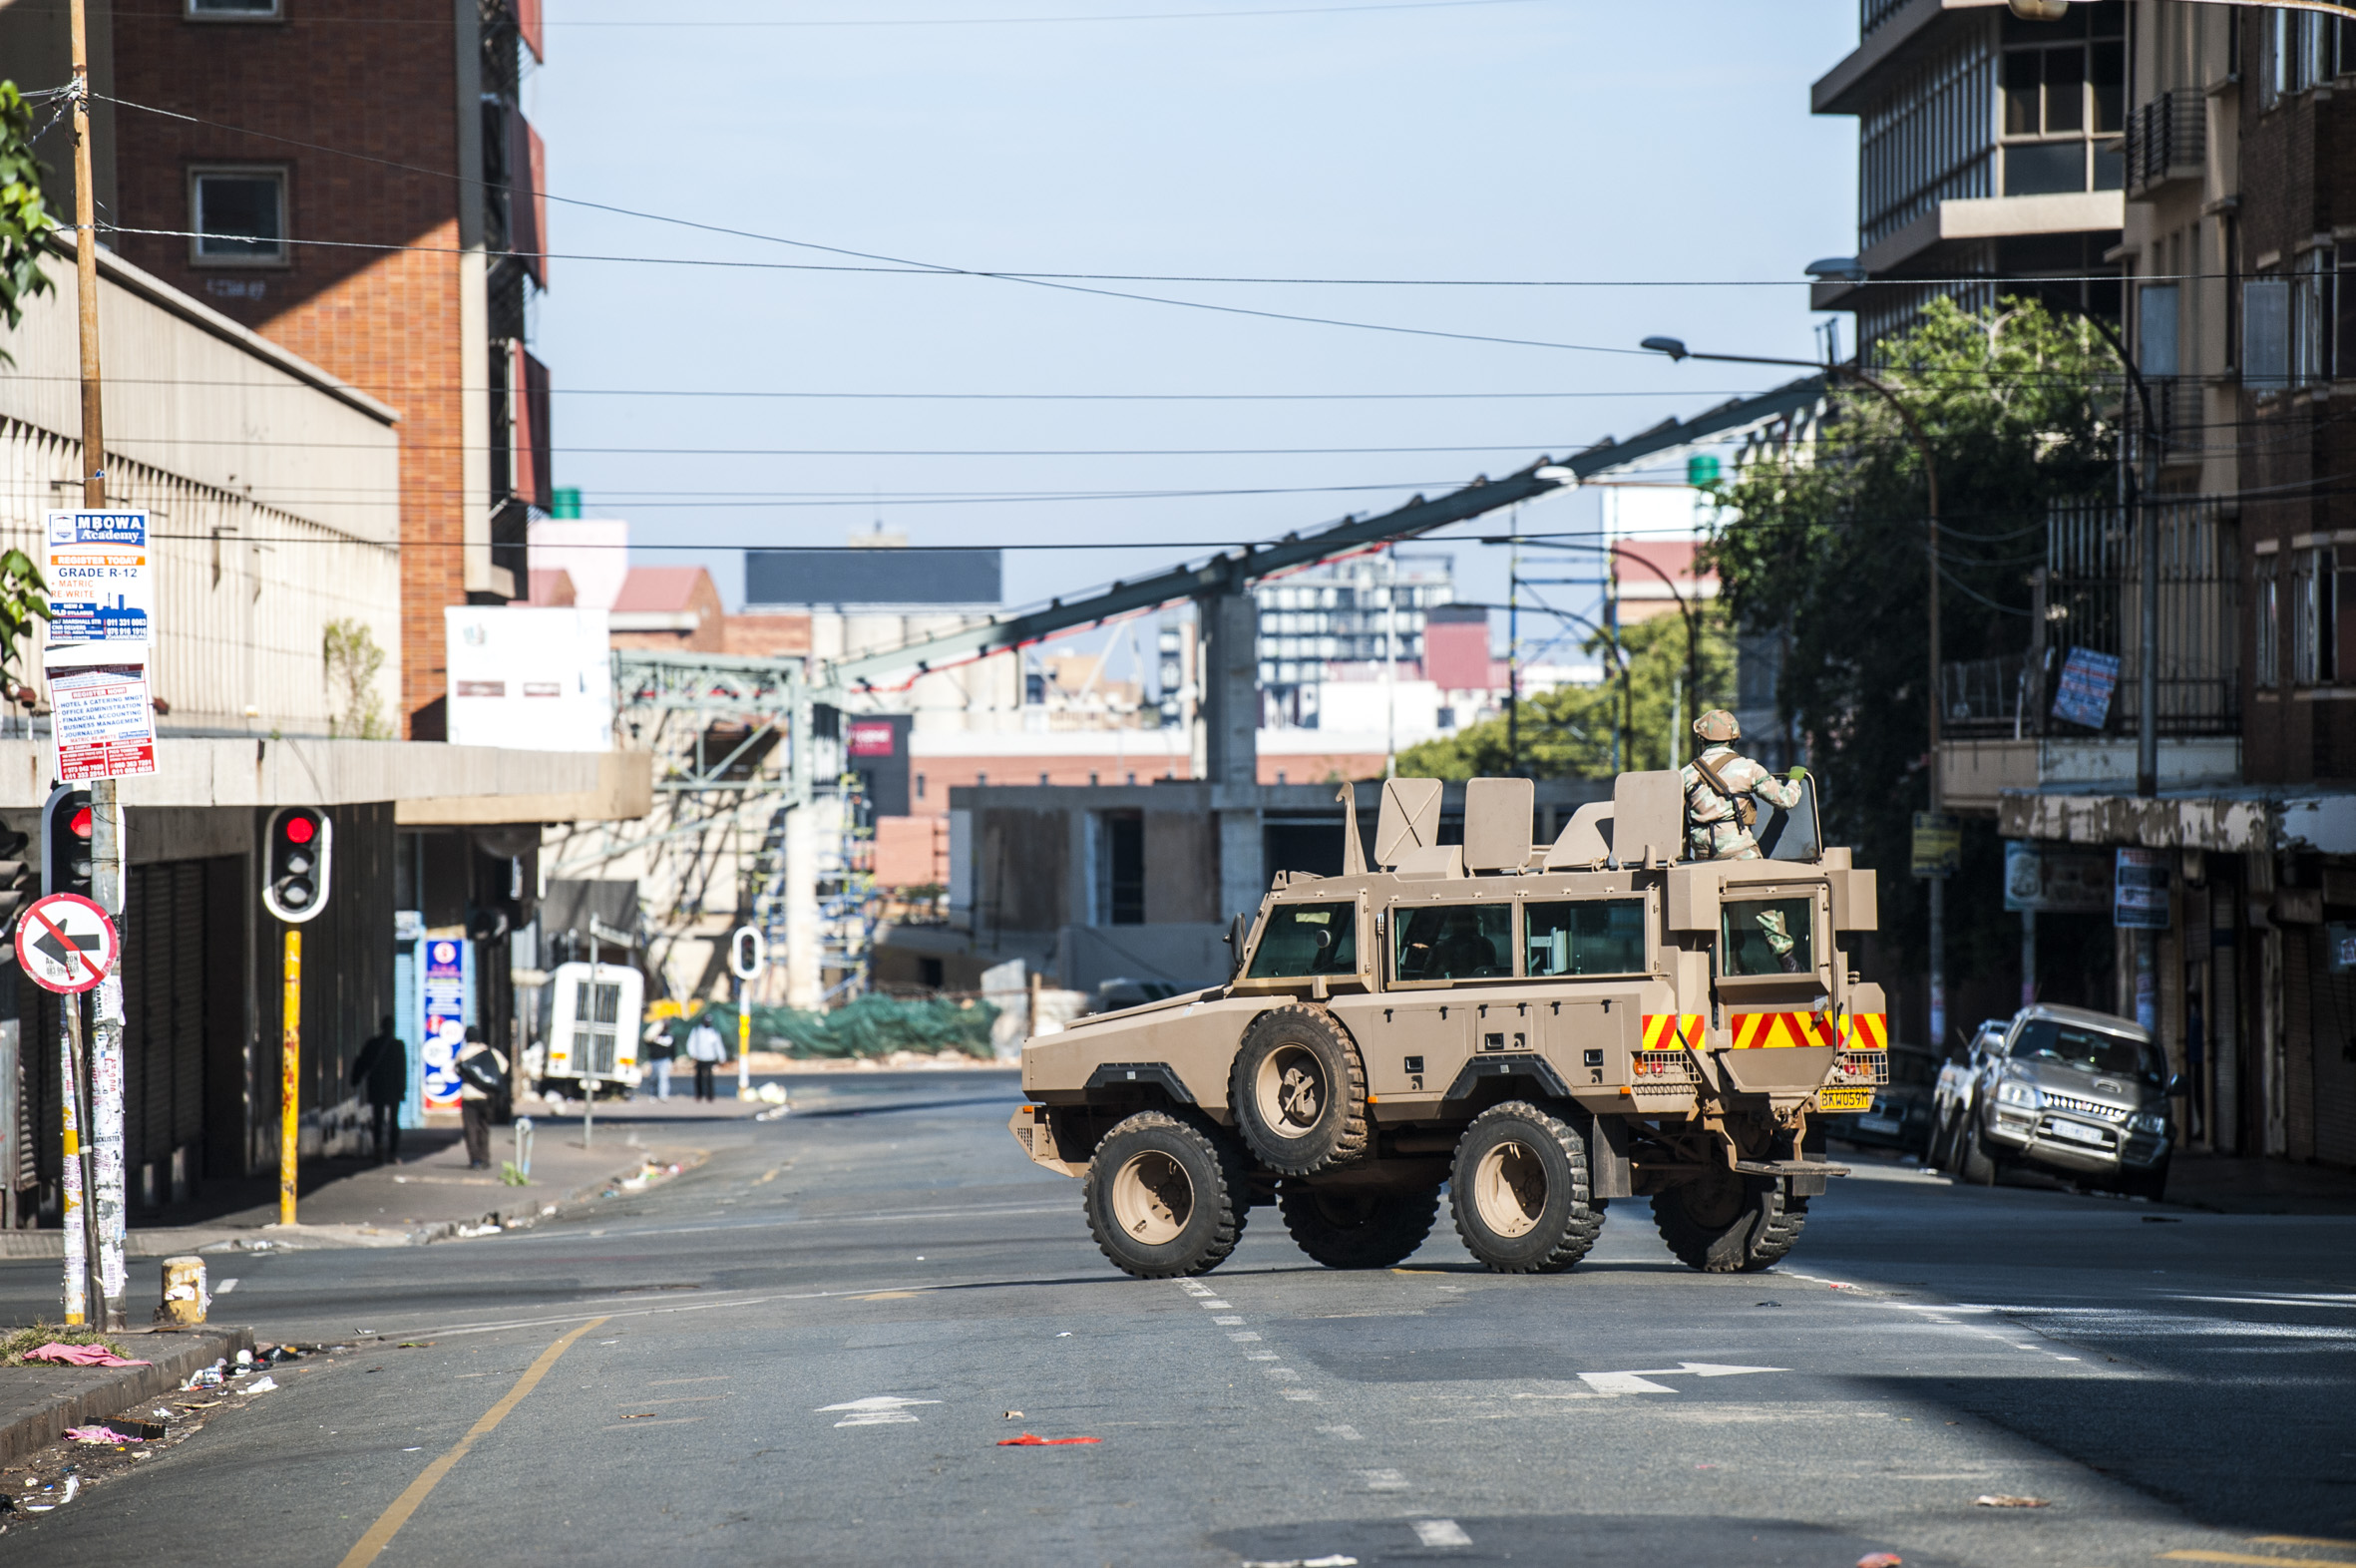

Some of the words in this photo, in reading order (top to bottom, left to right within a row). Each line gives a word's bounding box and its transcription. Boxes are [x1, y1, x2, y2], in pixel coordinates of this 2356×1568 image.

[78, 517, 142, 530] MBOWA
[81, 530, 139, 543] Academy
[58, 556, 105, 565] REGISTER
[107, 556, 138, 565] TODAY
[59, 568, 104, 578] GRADE
[110, 568, 138, 578] R-12
[73, 689, 106, 698] REGISTER
[86, 703, 142, 713] ADMINISTRATION
[98, 709, 142, 719] ACCOUNTING
[63, 721, 95, 730] BUSINESS
[97, 717, 143, 727] MANAGEMENT
[64, 729, 106, 739] JOURNALISM
[108, 1263, 117, 1296] ABORTION
